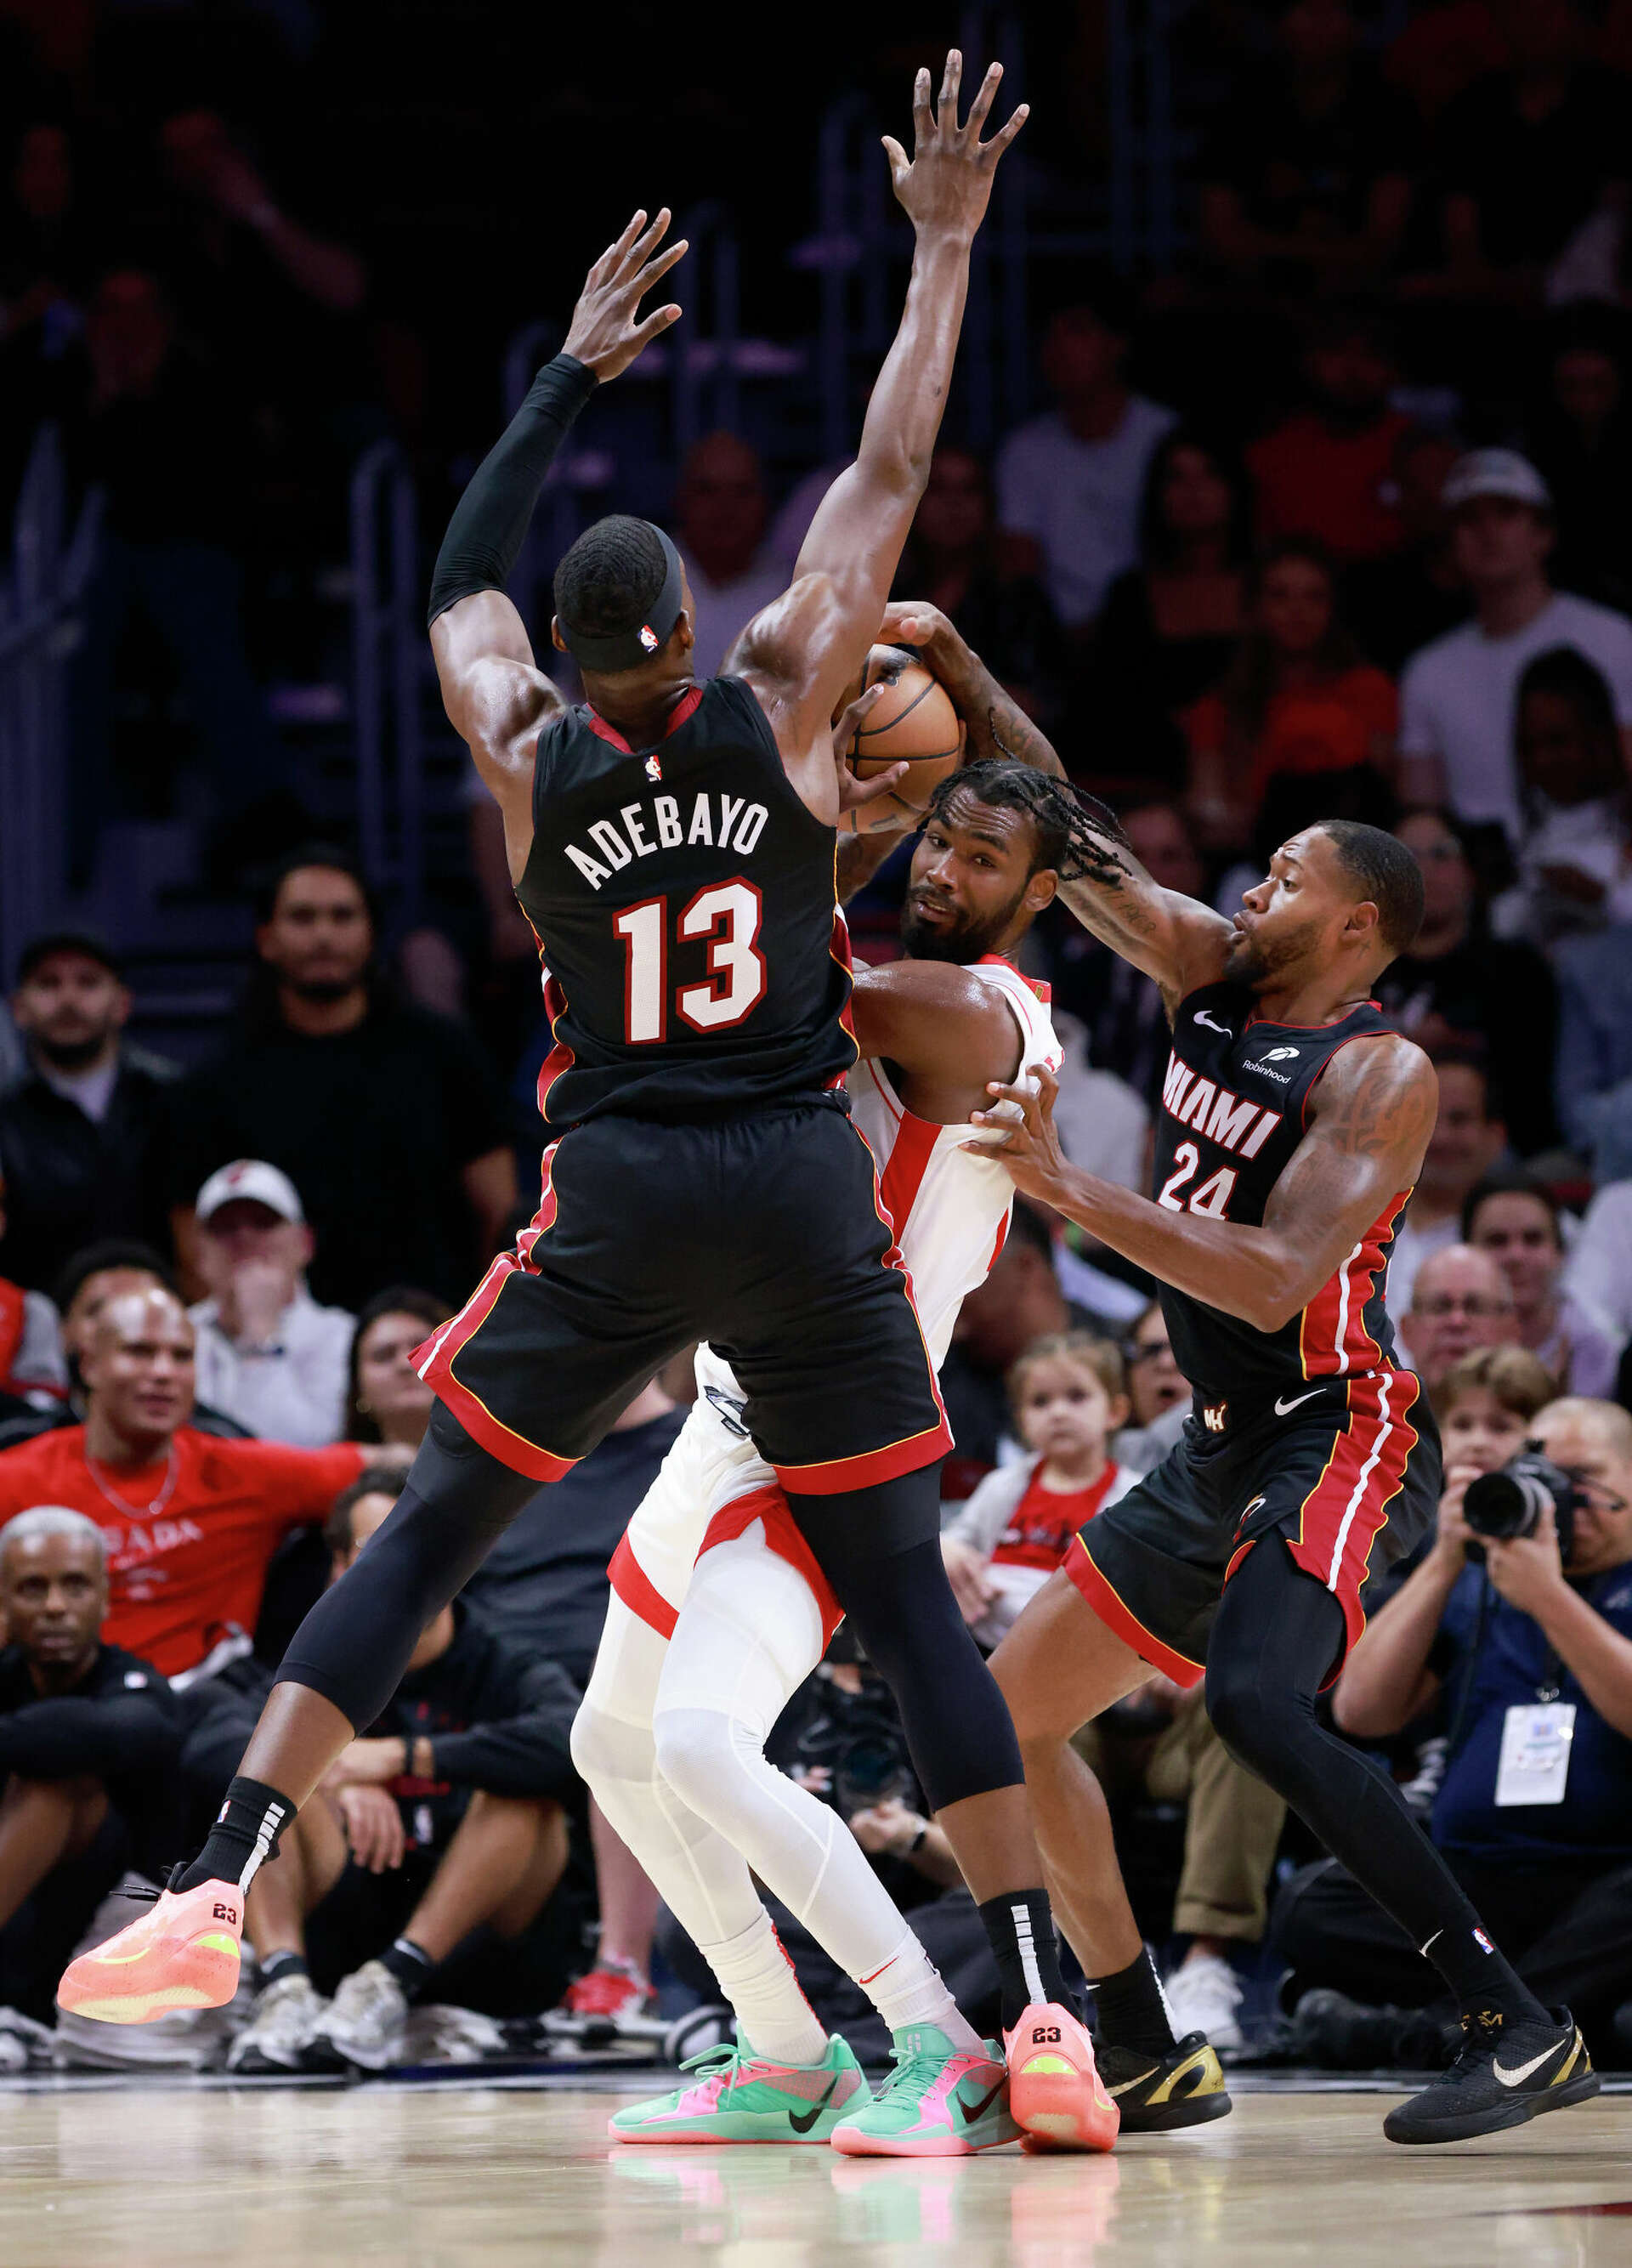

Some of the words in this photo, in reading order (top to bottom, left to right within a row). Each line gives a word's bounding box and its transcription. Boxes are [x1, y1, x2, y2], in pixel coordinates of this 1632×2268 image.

[564, 792, 768, 891] ADEBAYO
[612, 876, 768, 1045] 13
[1163, 1047, 1284, 1161] MIAMI
[1242, 1059, 1291, 1085] Robinhood
[1156, 1139, 1239, 1222] 24
[212, 1902, 237, 1925] 23
[1032, 2027, 1062, 2045] 23
